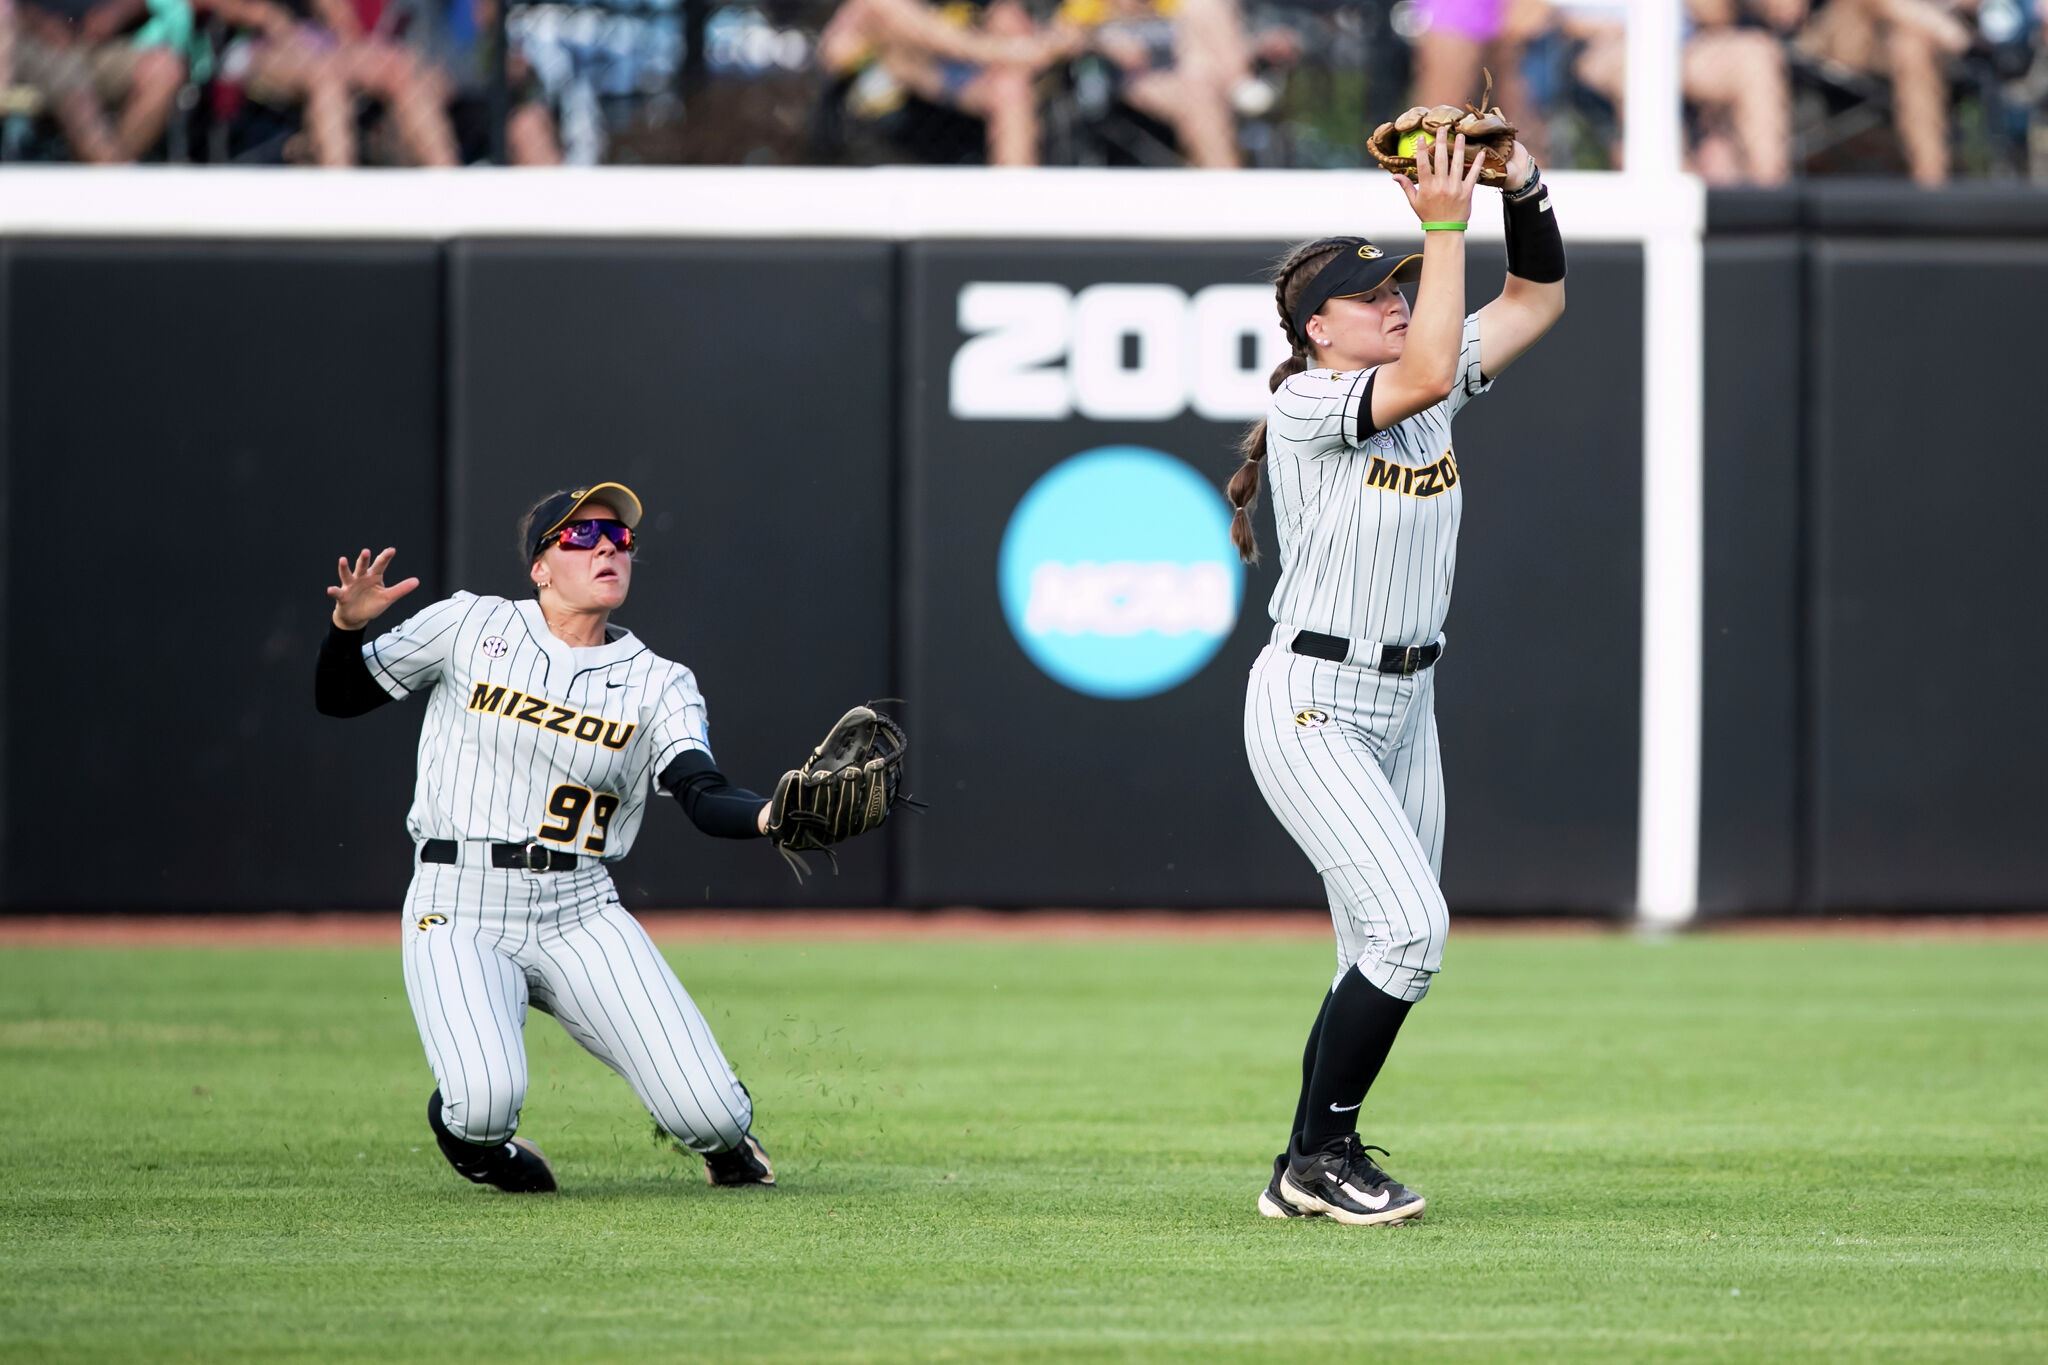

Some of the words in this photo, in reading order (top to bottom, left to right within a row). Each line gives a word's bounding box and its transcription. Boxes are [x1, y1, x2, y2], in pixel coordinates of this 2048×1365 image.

[949, 281, 1277, 421] 200
[483, 636, 508, 658] SEC
[466, 682, 638, 752] MIZZOU
[537, 784, 620, 855] 99
